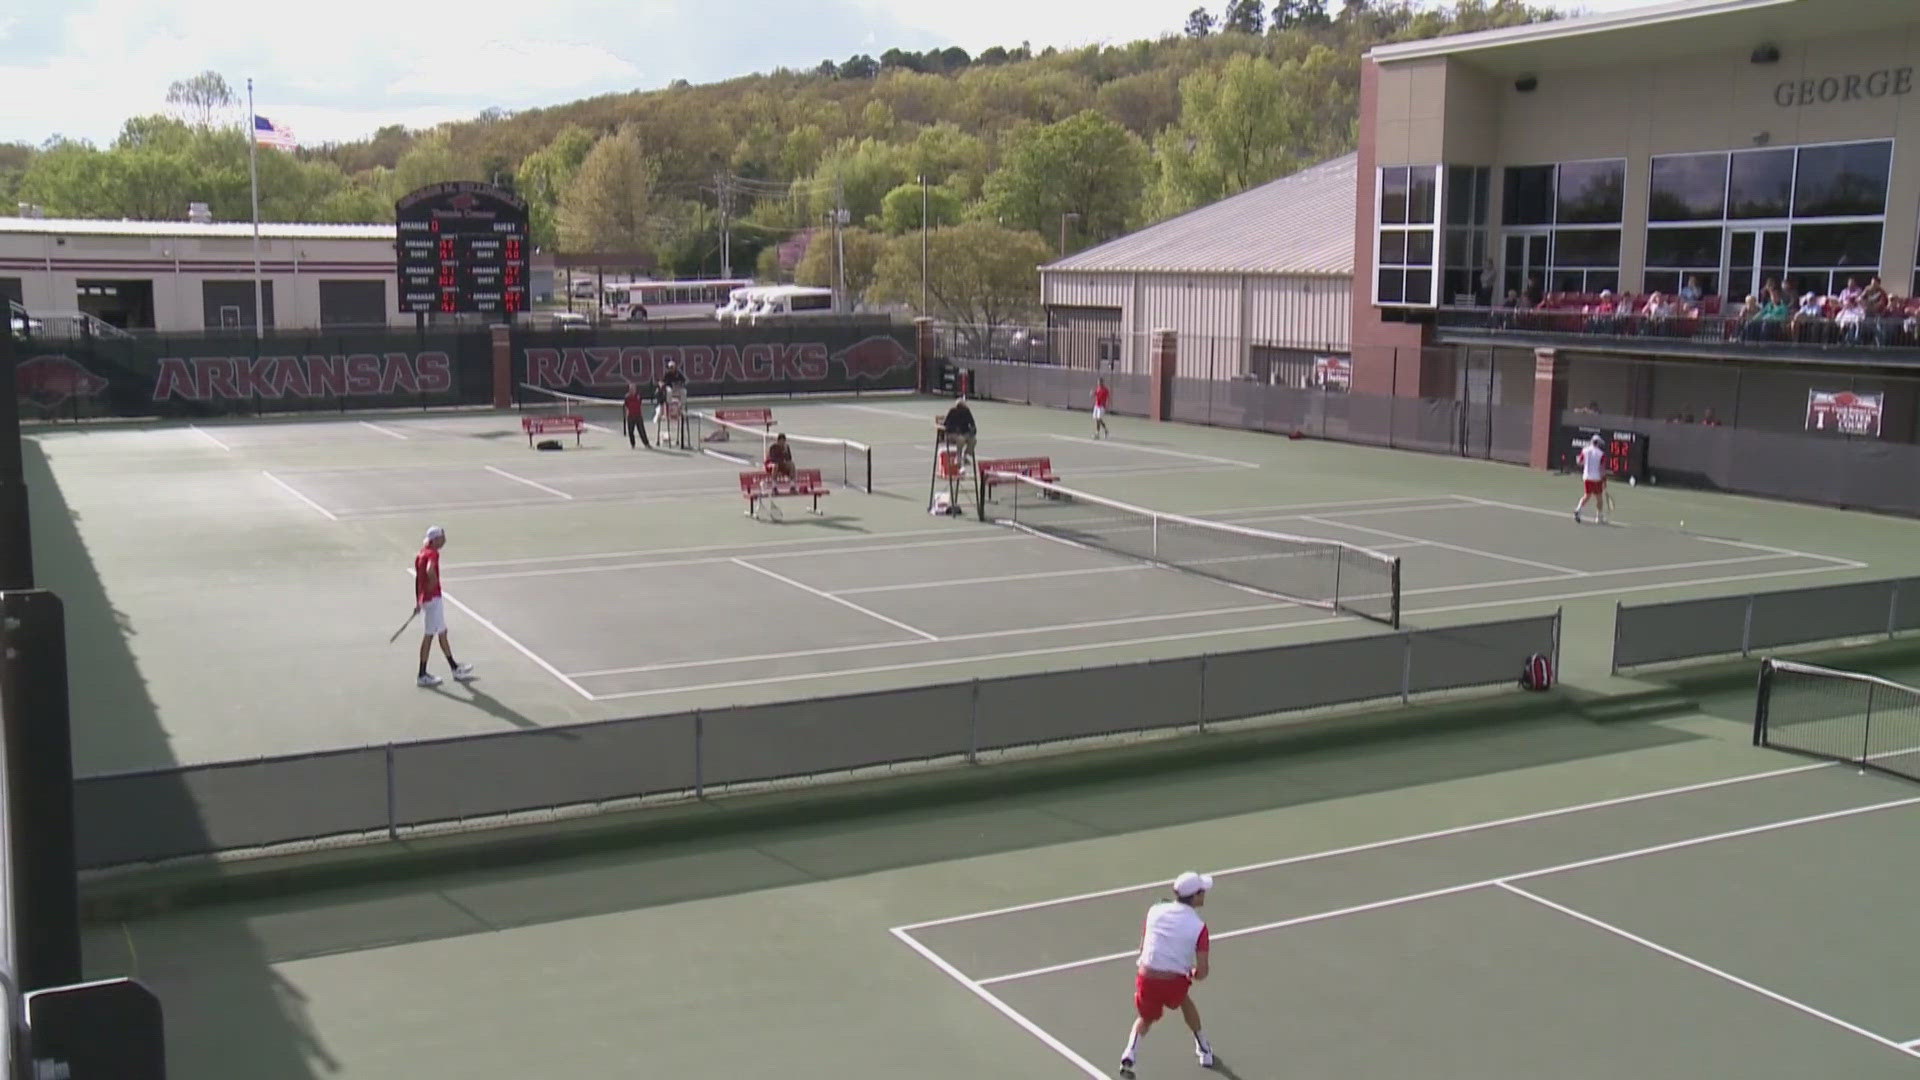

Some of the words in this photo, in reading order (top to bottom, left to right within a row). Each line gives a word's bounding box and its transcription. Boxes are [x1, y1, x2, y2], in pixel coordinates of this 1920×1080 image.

[1774, 67, 1913, 107] GEORGE
[400, 221, 429, 230] ARKANSAS
[493, 222, 515, 232] GUEST
[405, 240, 434, 248] ARKANSAS
[471, 240, 500, 249] ARKANSAS
[410, 250, 428, 258] GUEST
[477, 250, 494, 258] GUEST
[405, 266, 435, 274] ARKANSAS
[472, 266, 500, 274] ARKANSAS
[411, 276, 429, 284] GUEST
[477, 276, 495, 284] GUEST
[478, 302, 495, 310] GUEST
[524, 341, 829, 387] RAZORBACKS
[153, 352, 452, 401] ARKANSAS
[1836, 410, 1872, 422] CENTER
[1838, 419, 1868, 431] COURT
[1613, 431, 1631, 441] COURT
